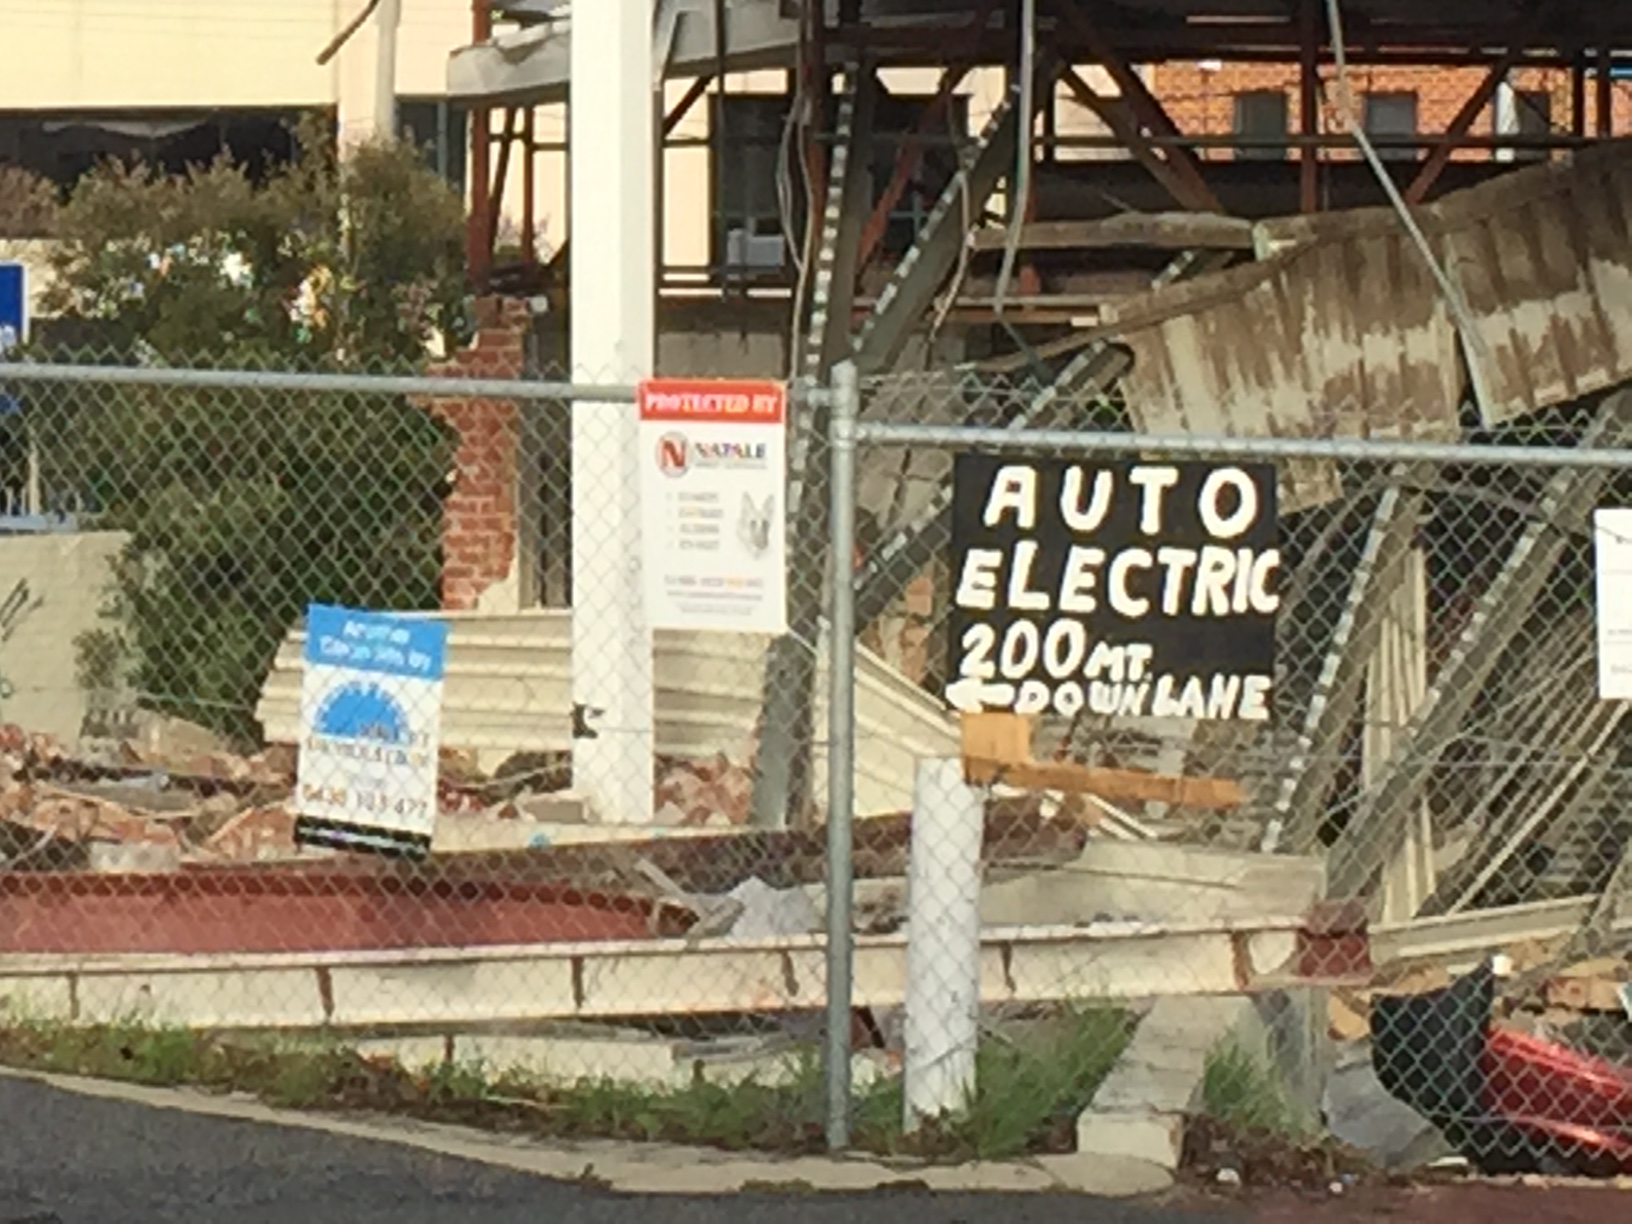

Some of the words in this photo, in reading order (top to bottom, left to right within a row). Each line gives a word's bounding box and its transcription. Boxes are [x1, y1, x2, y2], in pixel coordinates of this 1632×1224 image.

[645, 393, 749, 413] PROTECTED
[752, 393, 778, 413] BY
[983, 465, 1257, 538] AUTO
[955, 541, 1281, 617] ELECTRIC
[1014, 680, 1150, 717] DOWN
[1152, 673, 1272, 720] LANE
